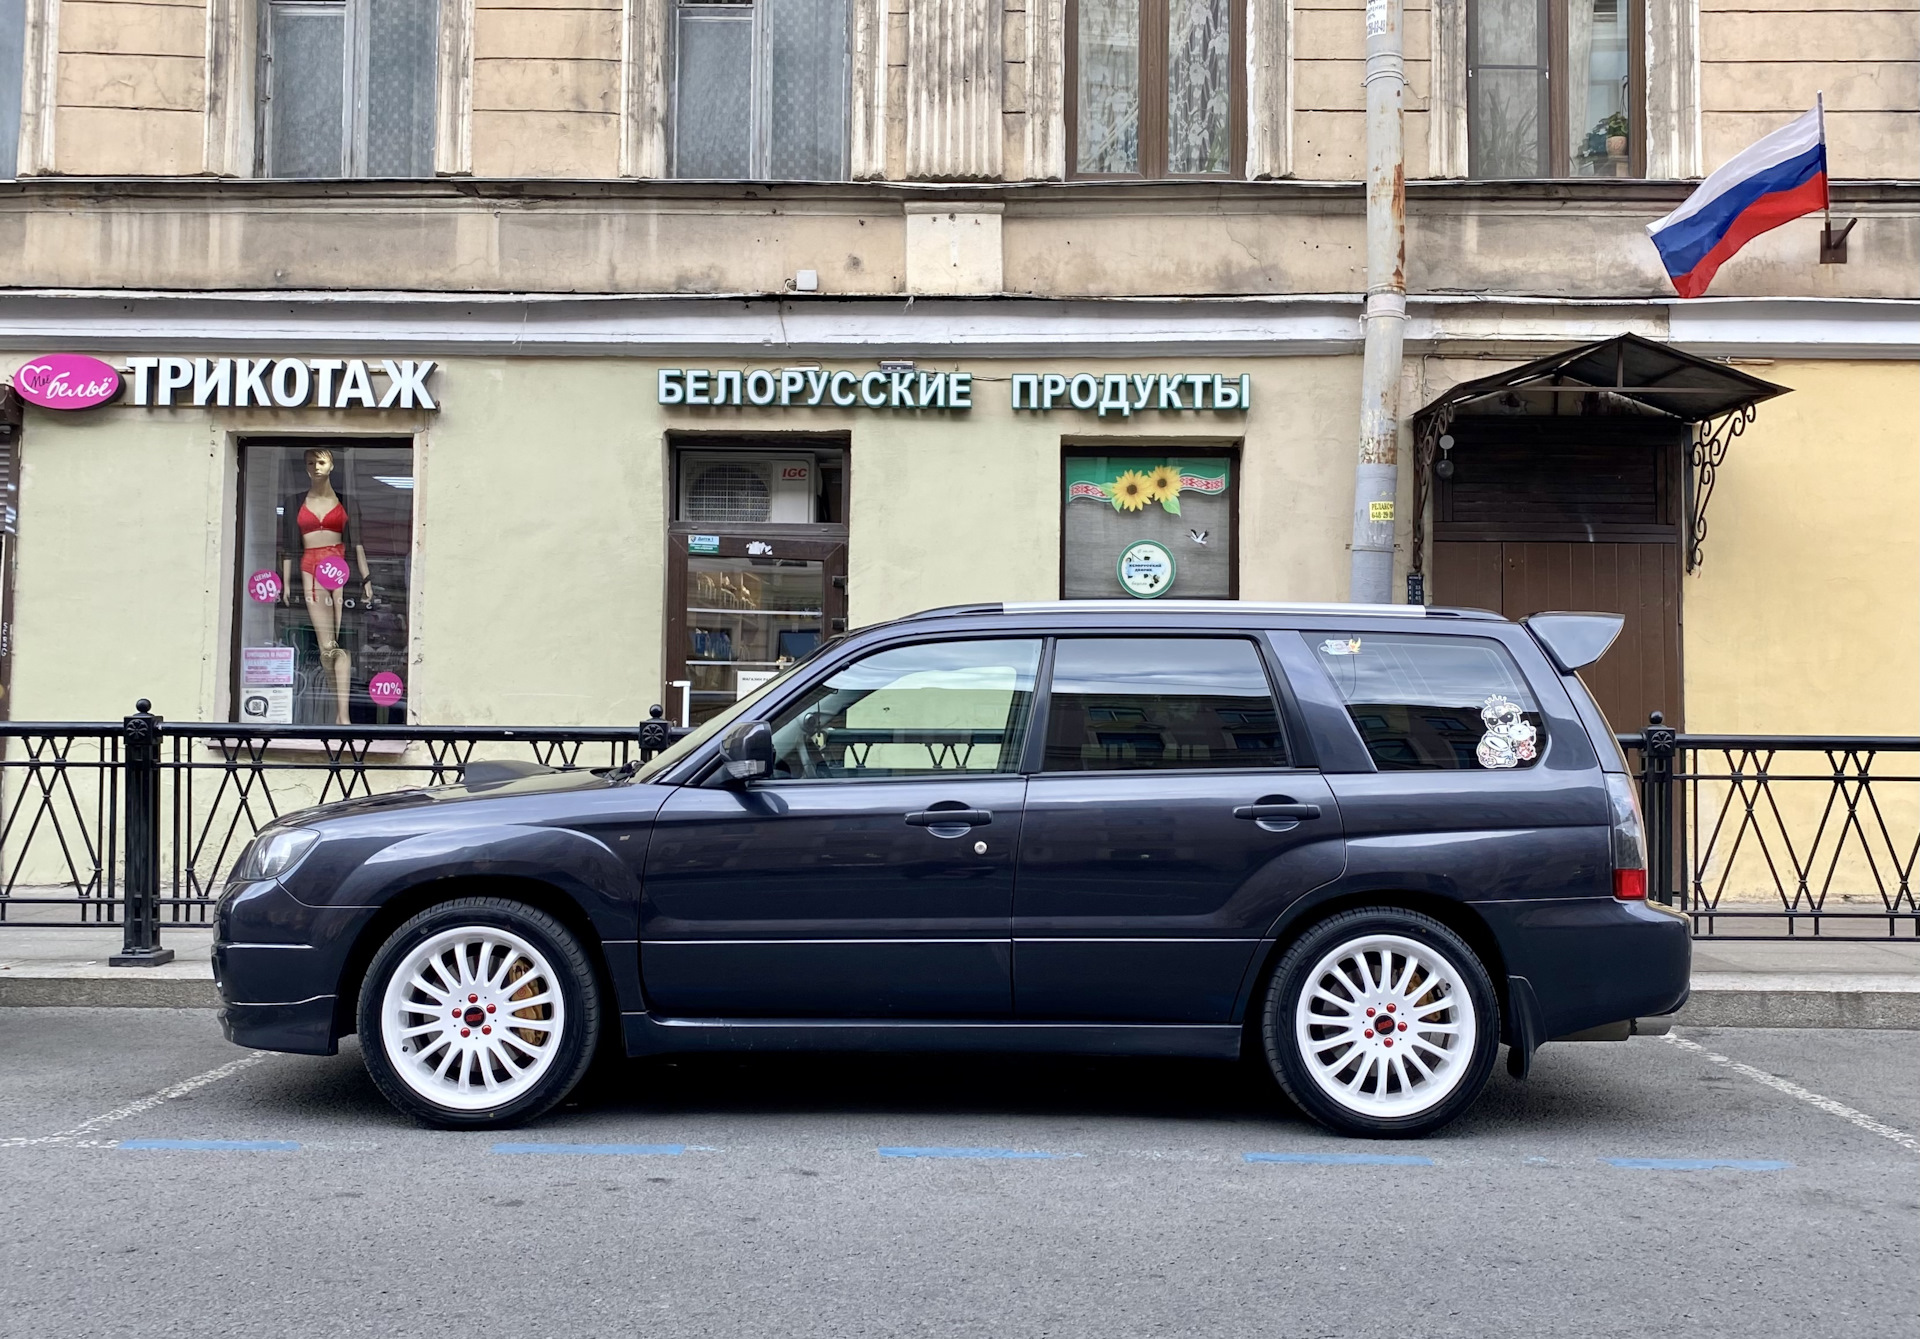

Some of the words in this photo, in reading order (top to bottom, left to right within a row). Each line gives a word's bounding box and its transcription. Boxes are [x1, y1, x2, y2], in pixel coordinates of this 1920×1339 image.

[45, 371, 114, 399] бельё
[126, 357, 438, 409] ТРИКОТАЖ
[657, 368, 973, 408] БЕЛОРУССКИЕ
[1011, 373, 1251, 417] ПРОДУКТЫ
[782, 468, 808, 478] IGC
[253, 571, 272, 582] ЦЕНЫ
[319, 562, 347, 585] -30%
[255, 579, 277, 601] 99
[371, 682, 402, 696] -70%
